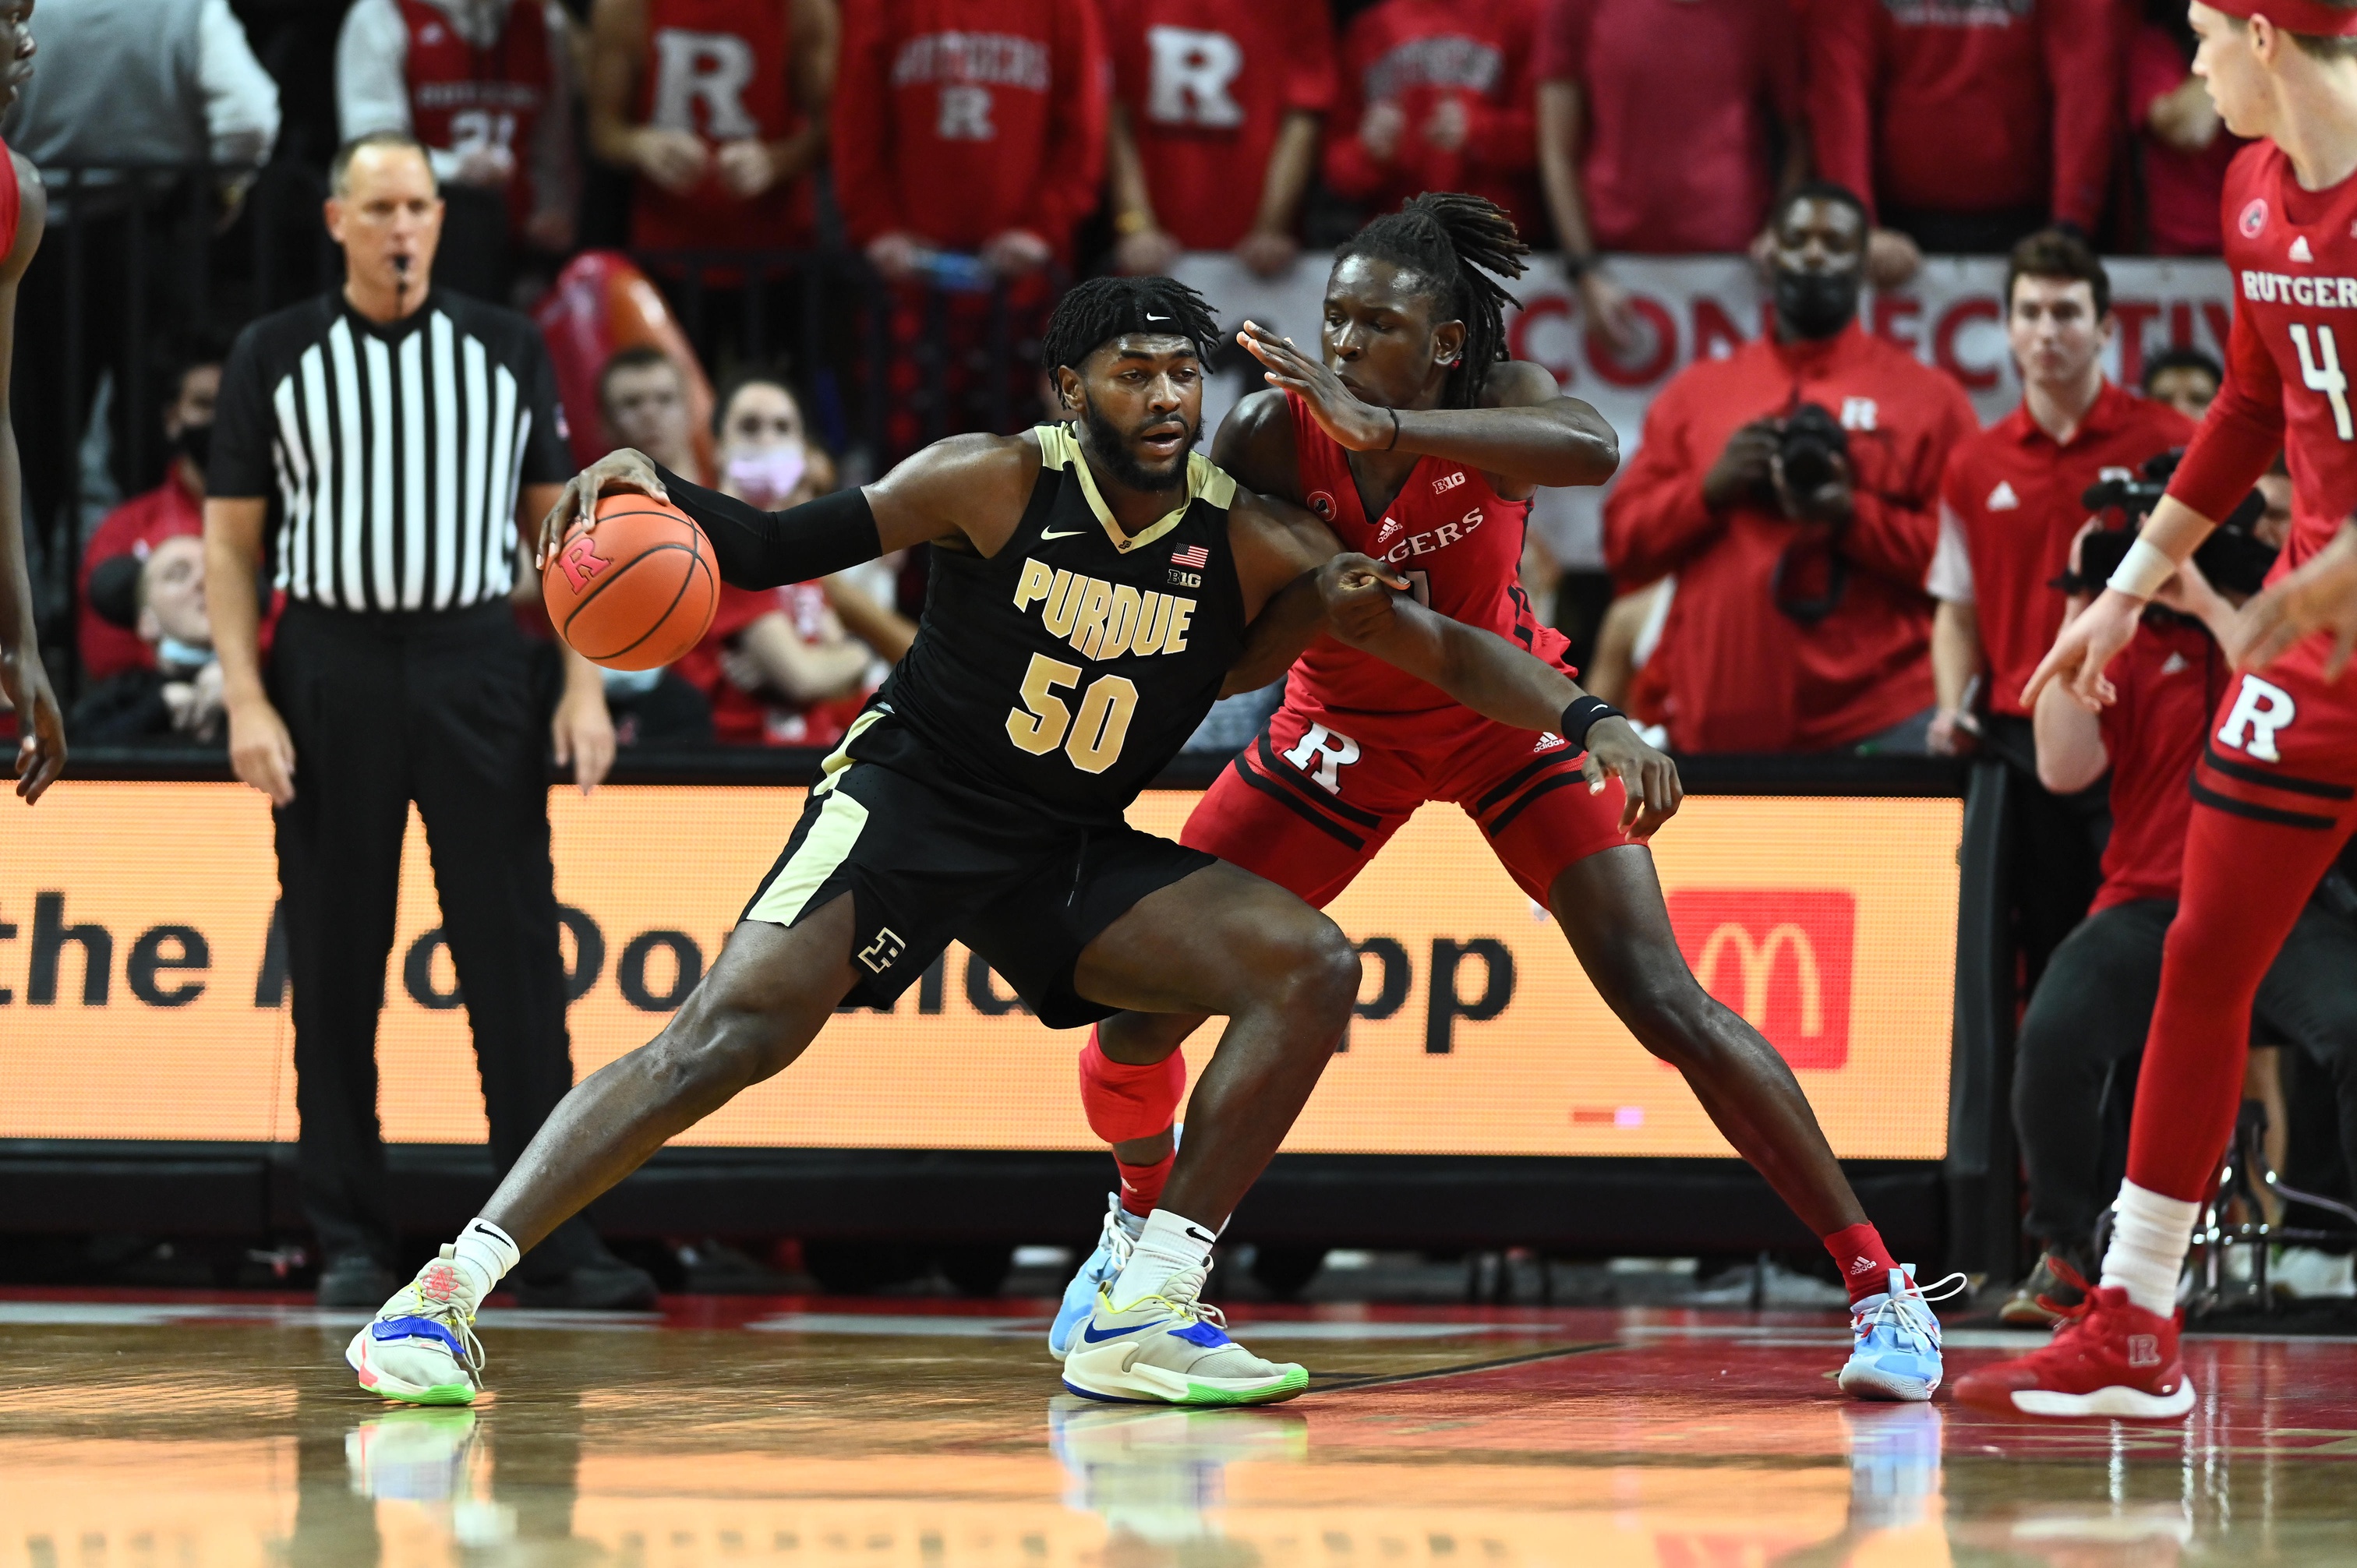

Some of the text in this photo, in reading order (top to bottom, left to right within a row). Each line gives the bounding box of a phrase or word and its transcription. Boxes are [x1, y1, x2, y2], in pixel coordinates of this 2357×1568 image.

[654, 29, 758, 140] R
[938, 86, 998, 142] R
[1148, 25, 1245, 128] R
[2288, 323, 2355, 440] 4
[558, 537, 612, 596] R
[1377, 523, 1403, 543] adidas
[1012, 556, 1197, 662] PURDUE
[1005, 651, 1139, 775] 50
[1283, 720, 1362, 796] R
[1533, 738, 1565, 753] adidas
[2217, 673, 2296, 763] R
[1334, 937, 1517, 1054] pp
[2128, 1333, 2162, 1368] R
